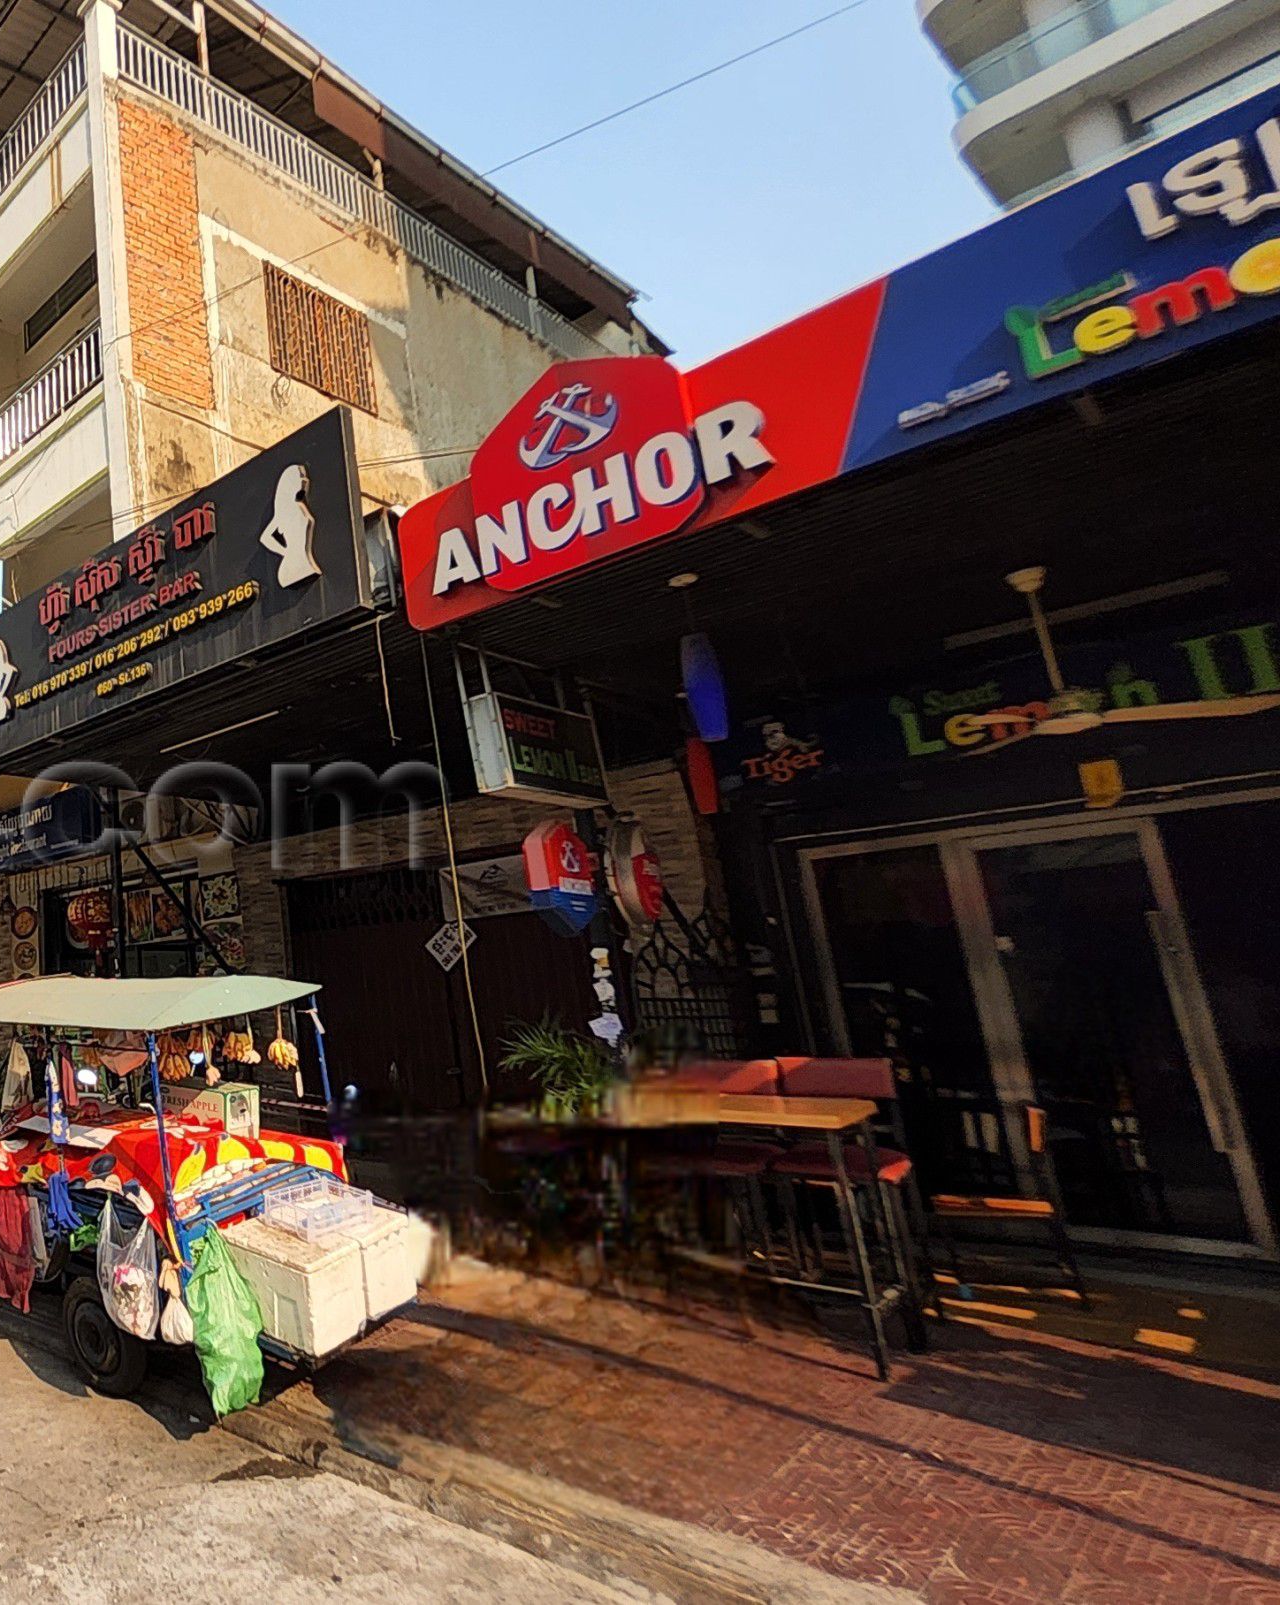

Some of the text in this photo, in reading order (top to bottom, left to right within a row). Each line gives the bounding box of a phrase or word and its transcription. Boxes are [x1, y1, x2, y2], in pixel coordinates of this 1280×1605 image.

[432, 400, 776, 596] ANCHOR
[31, 680, 50, 699] 016
[50, 672, 67, 691] 970
[68, 661, 89, 683] 339
[95, 649, 115, 669] 016
[116, 636, 140, 660] 206
[139, 625, 163, 648] 292
[172, 608, 196, 632] 093
[199, 594, 224, 619] 939
[226, 580, 256, 608] 266
[48, 571, 198, 662] FOURS SISTER BAR
[502, 708, 558, 740] SWEET
[741, 748, 824, 783] Tiger
[190, 1099, 219, 1113] APPLE
